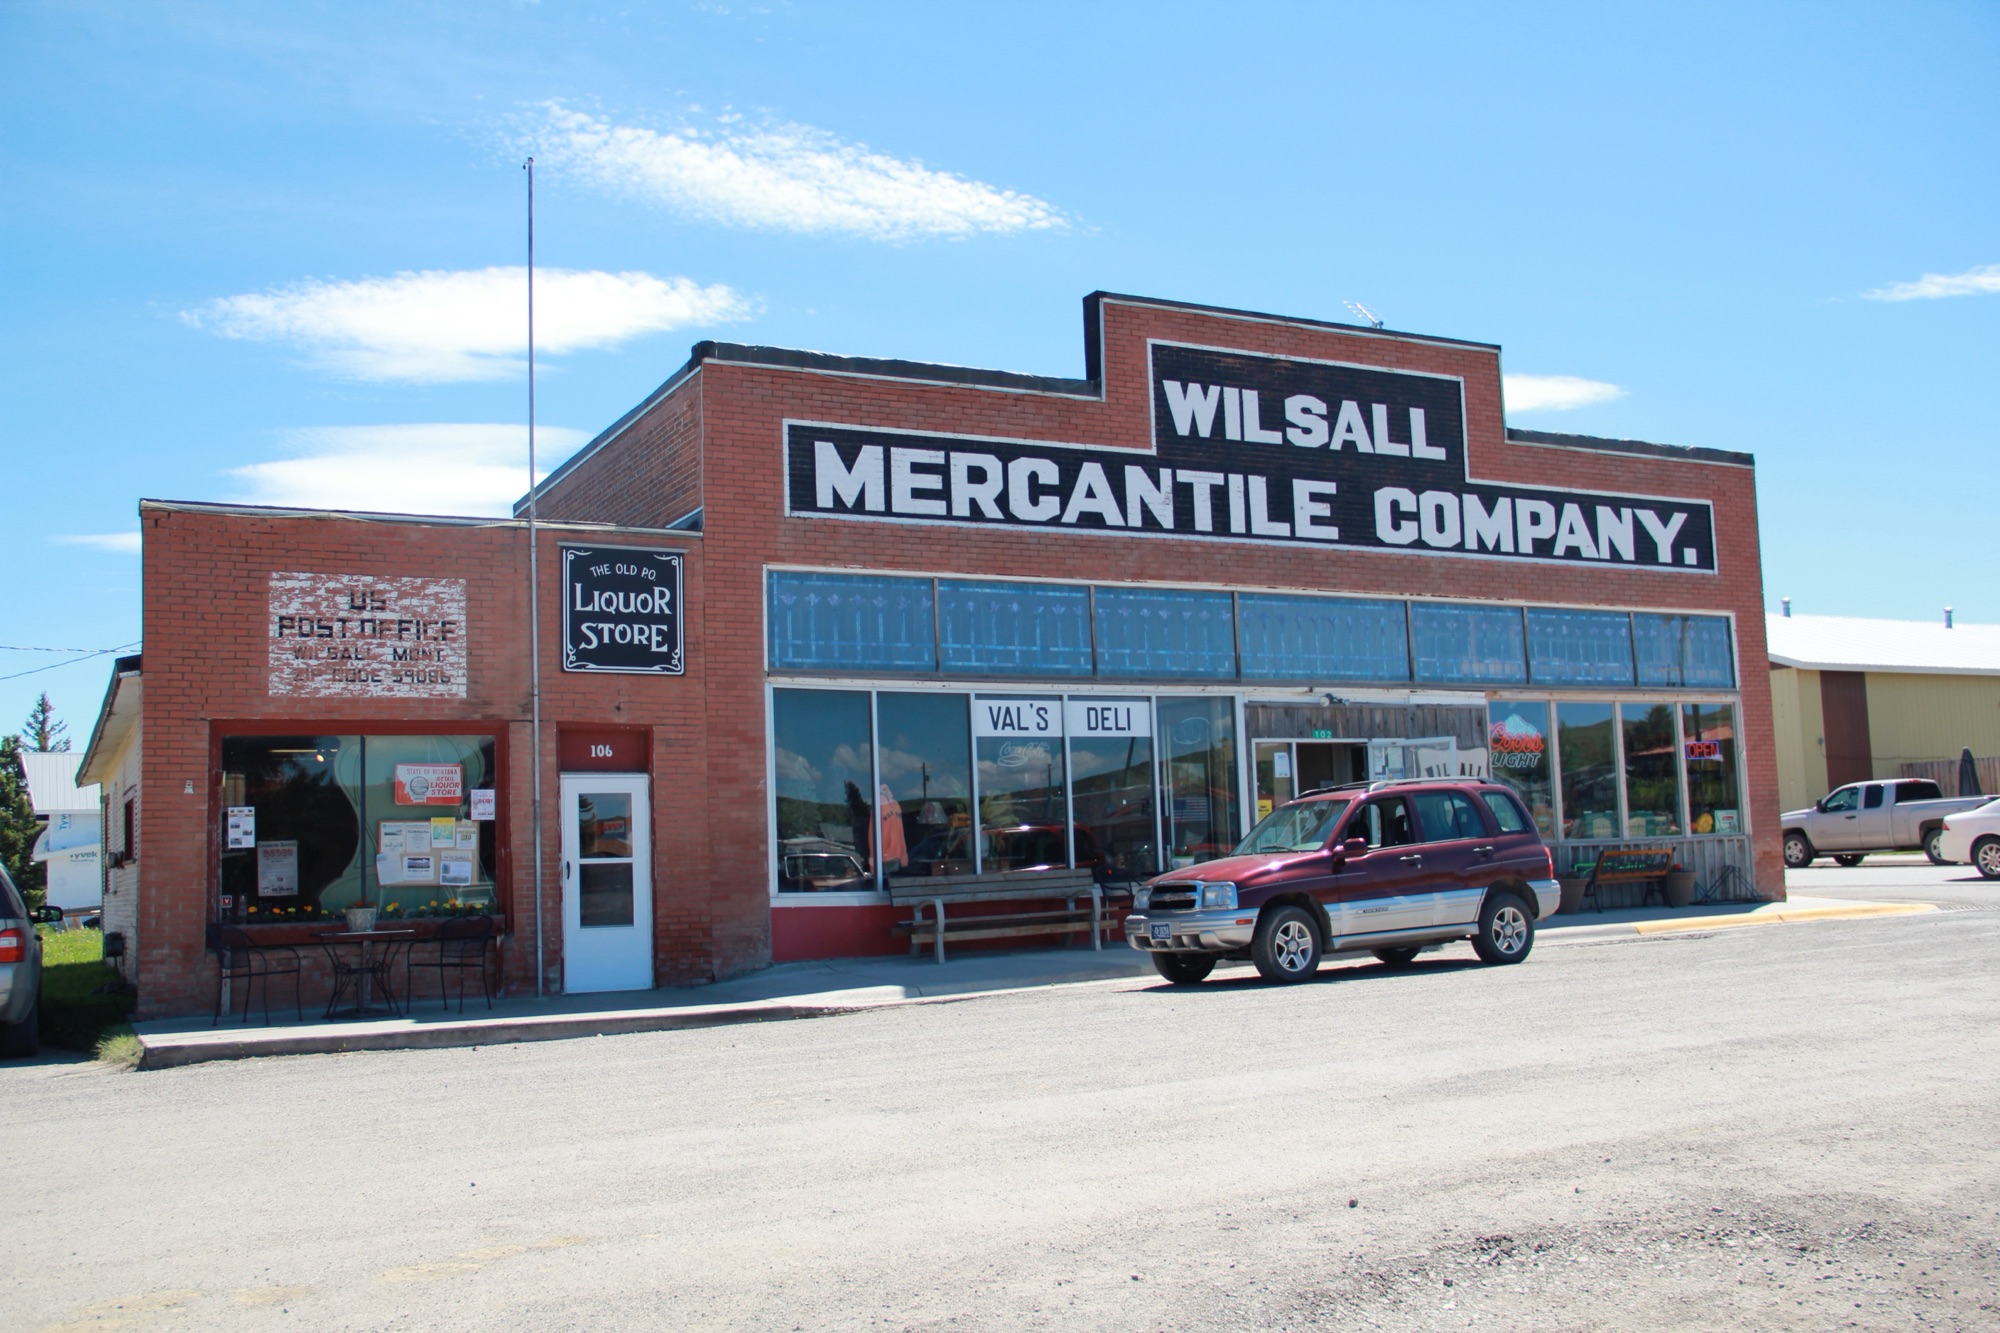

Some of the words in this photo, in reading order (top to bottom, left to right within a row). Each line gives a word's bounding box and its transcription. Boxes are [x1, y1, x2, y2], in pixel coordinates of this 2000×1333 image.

[1162, 380, 1446, 461] WILSALL
[814, 441, 1340, 541] MERCANTILE
[1374, 486, 1698, 566] COMPANY.
[590, 563, 611, 577] THE
[615, 563, 637, 576] OLD
[278, 615, 352, 639] POST
[988, 703, 1049, 731] VAL'S
[1086, 706, 1131, 731] DELI
[1314, 730, 1332, 739] 102
[1489, 721, 1545, 753] Coors
[590, 744, 613, 758] 106
[1490, 752, 1541, 768] LIGHT
[1687, 743, 1718, 758] OPEN
